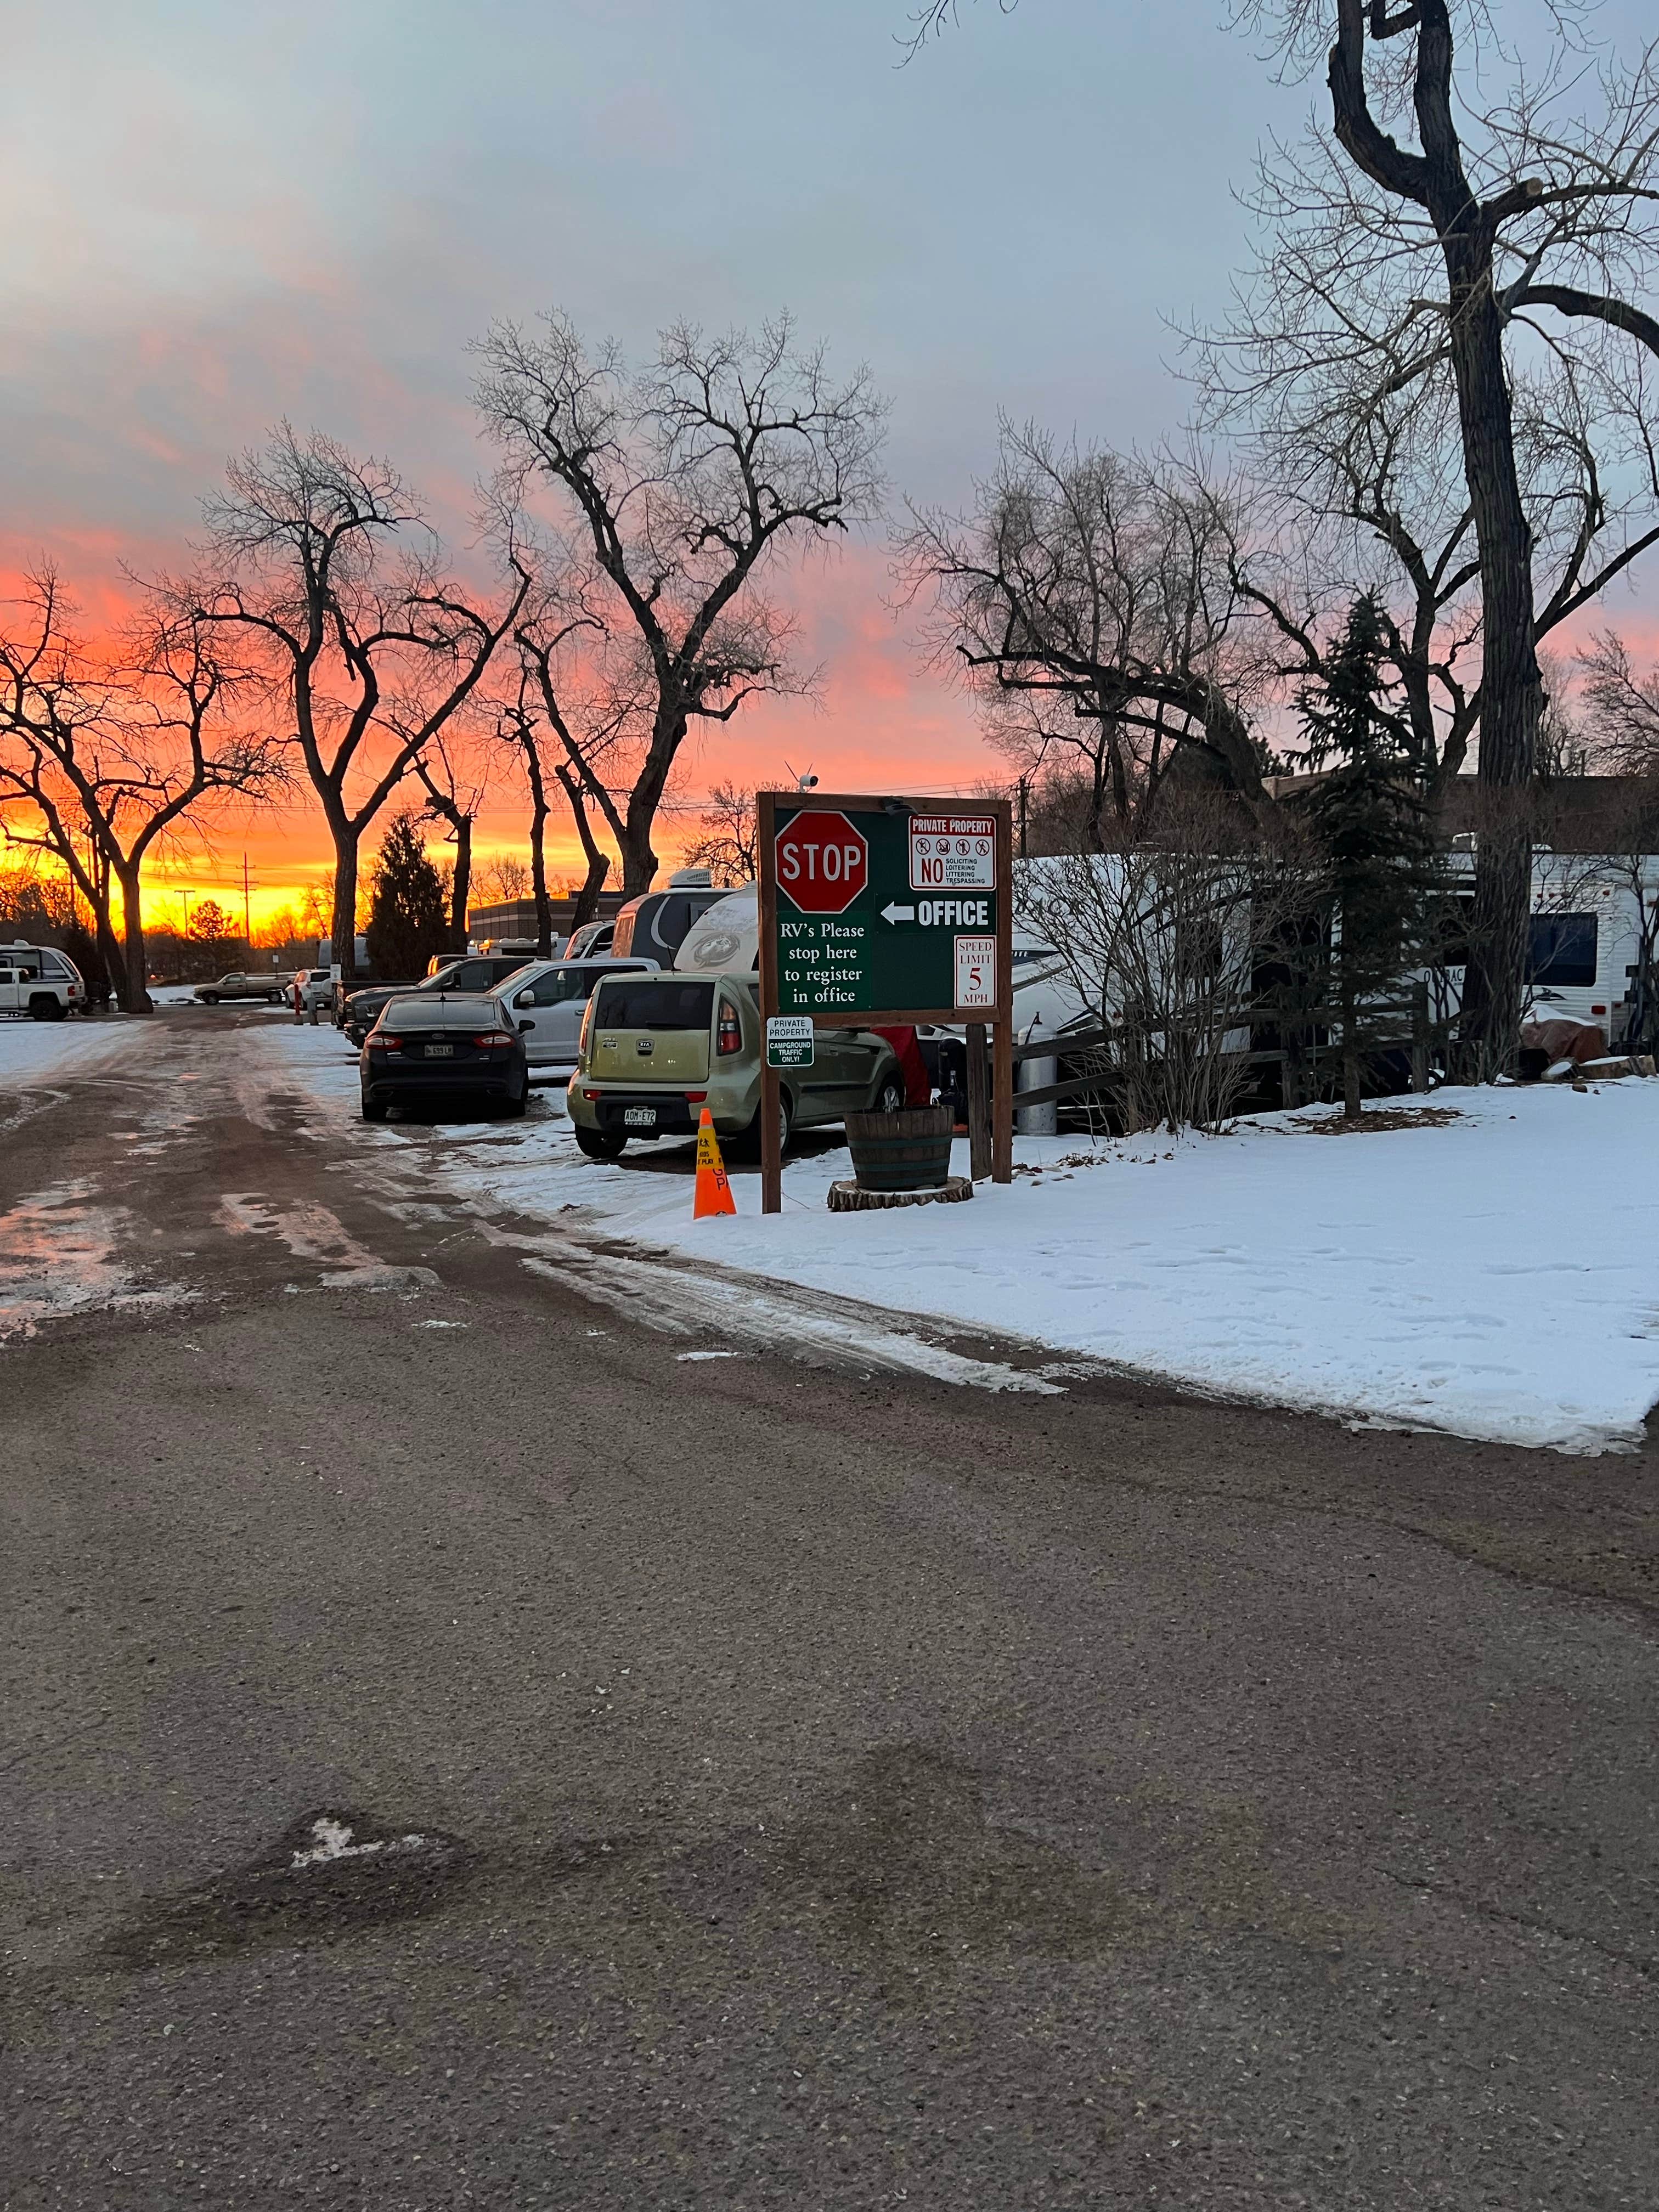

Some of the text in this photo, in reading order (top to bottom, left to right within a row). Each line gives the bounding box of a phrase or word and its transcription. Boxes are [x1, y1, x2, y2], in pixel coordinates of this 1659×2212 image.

[912, 819, 992, 833] PRIVATE PROPERTY
[782, 843, 861, 881] STOP
[922, 858, 943, 883] NO
[918, 900, 989, 926] OFFICE
[780, 922, 865, 937] RV's Please
[789, 944, 857, 963] stop here
[959, 942, 992, 951] SPEED
[960, 955, 991, 964] LIMIT
[785, 966, 862, 985] to register
[969, 967, 981, 990] 5
[793, 988, 855, 1002] in office
[963, 994, 988, 1003] MPH
